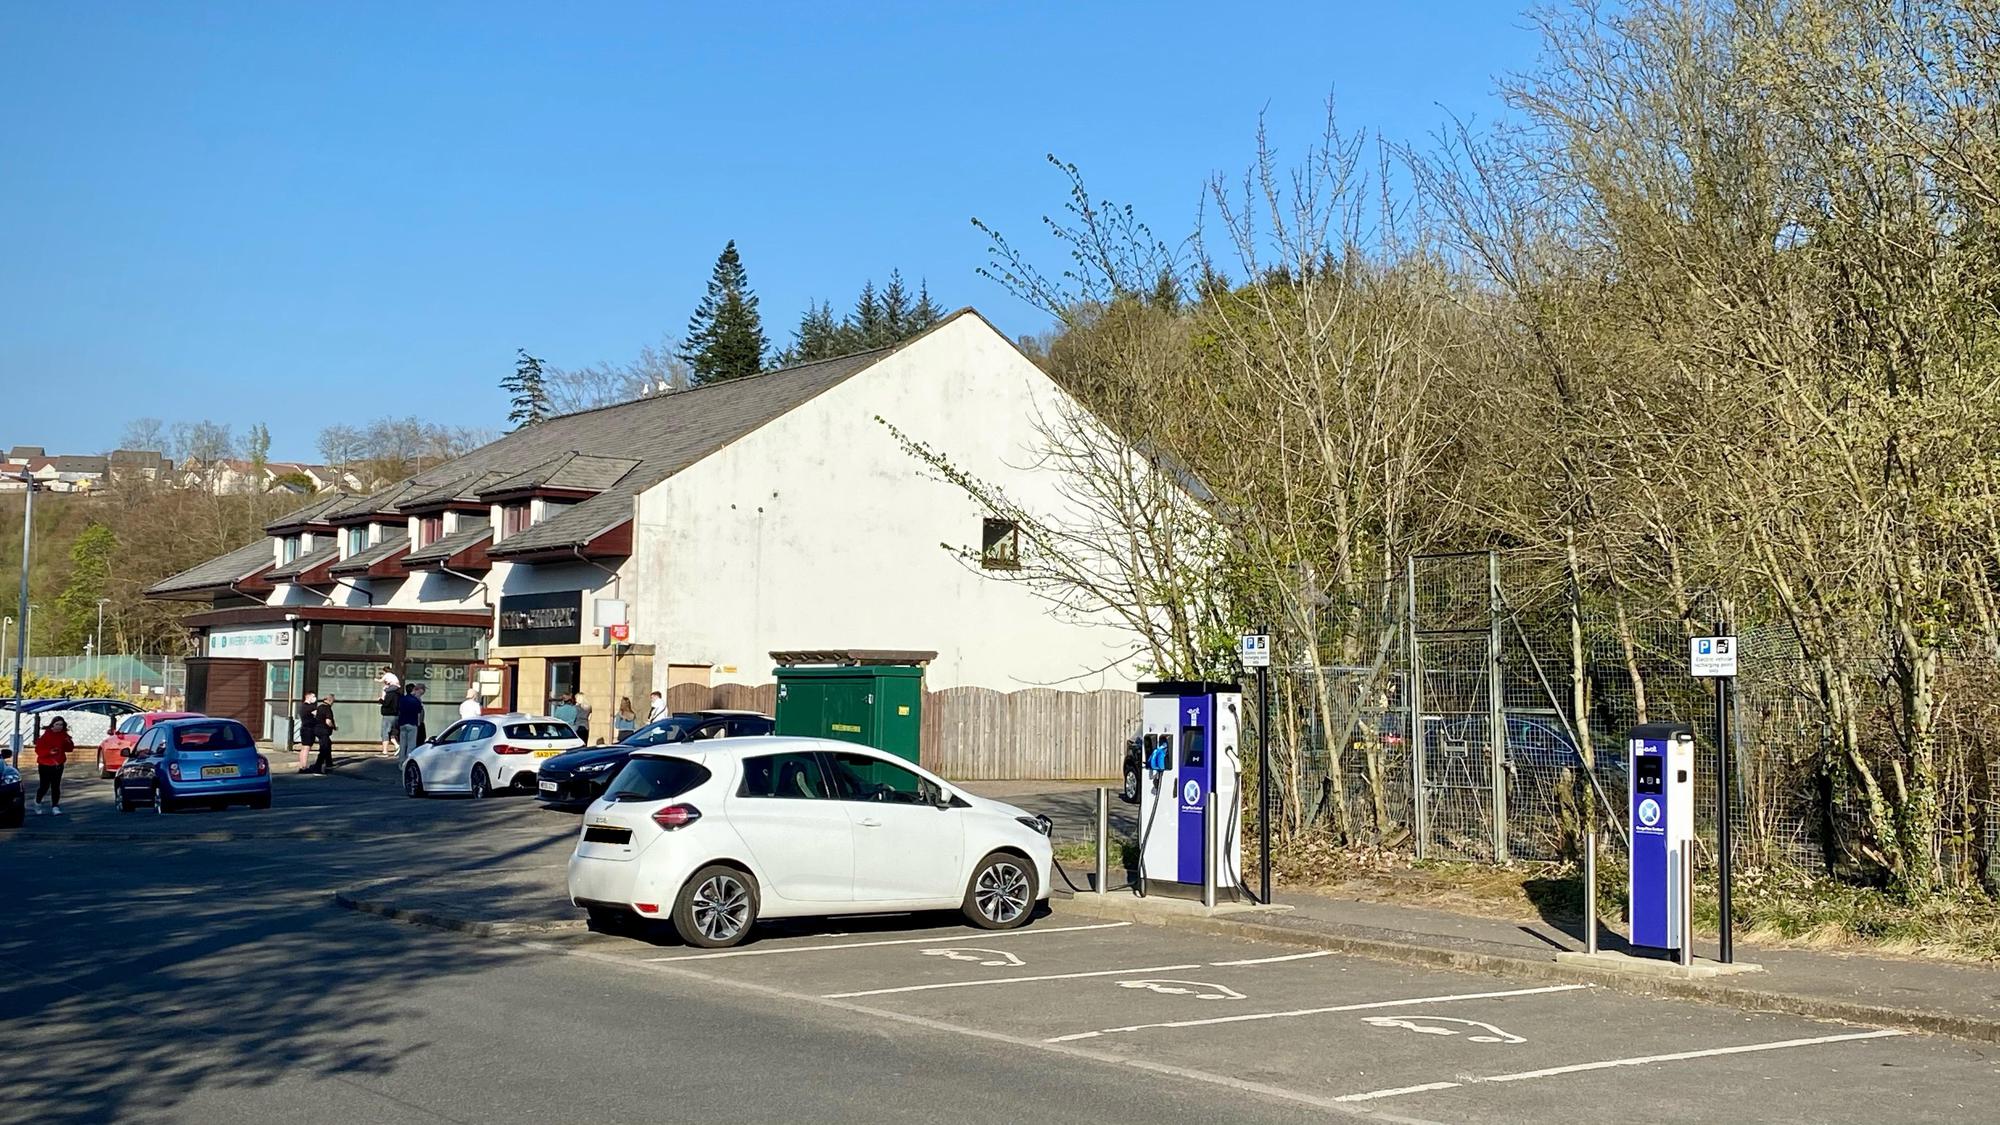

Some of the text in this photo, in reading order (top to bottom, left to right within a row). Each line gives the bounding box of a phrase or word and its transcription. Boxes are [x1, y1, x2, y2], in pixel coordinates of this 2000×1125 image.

[1700, 641, 1709, 653] P
[325, 664, 464, 680] COFFEE SHOP
